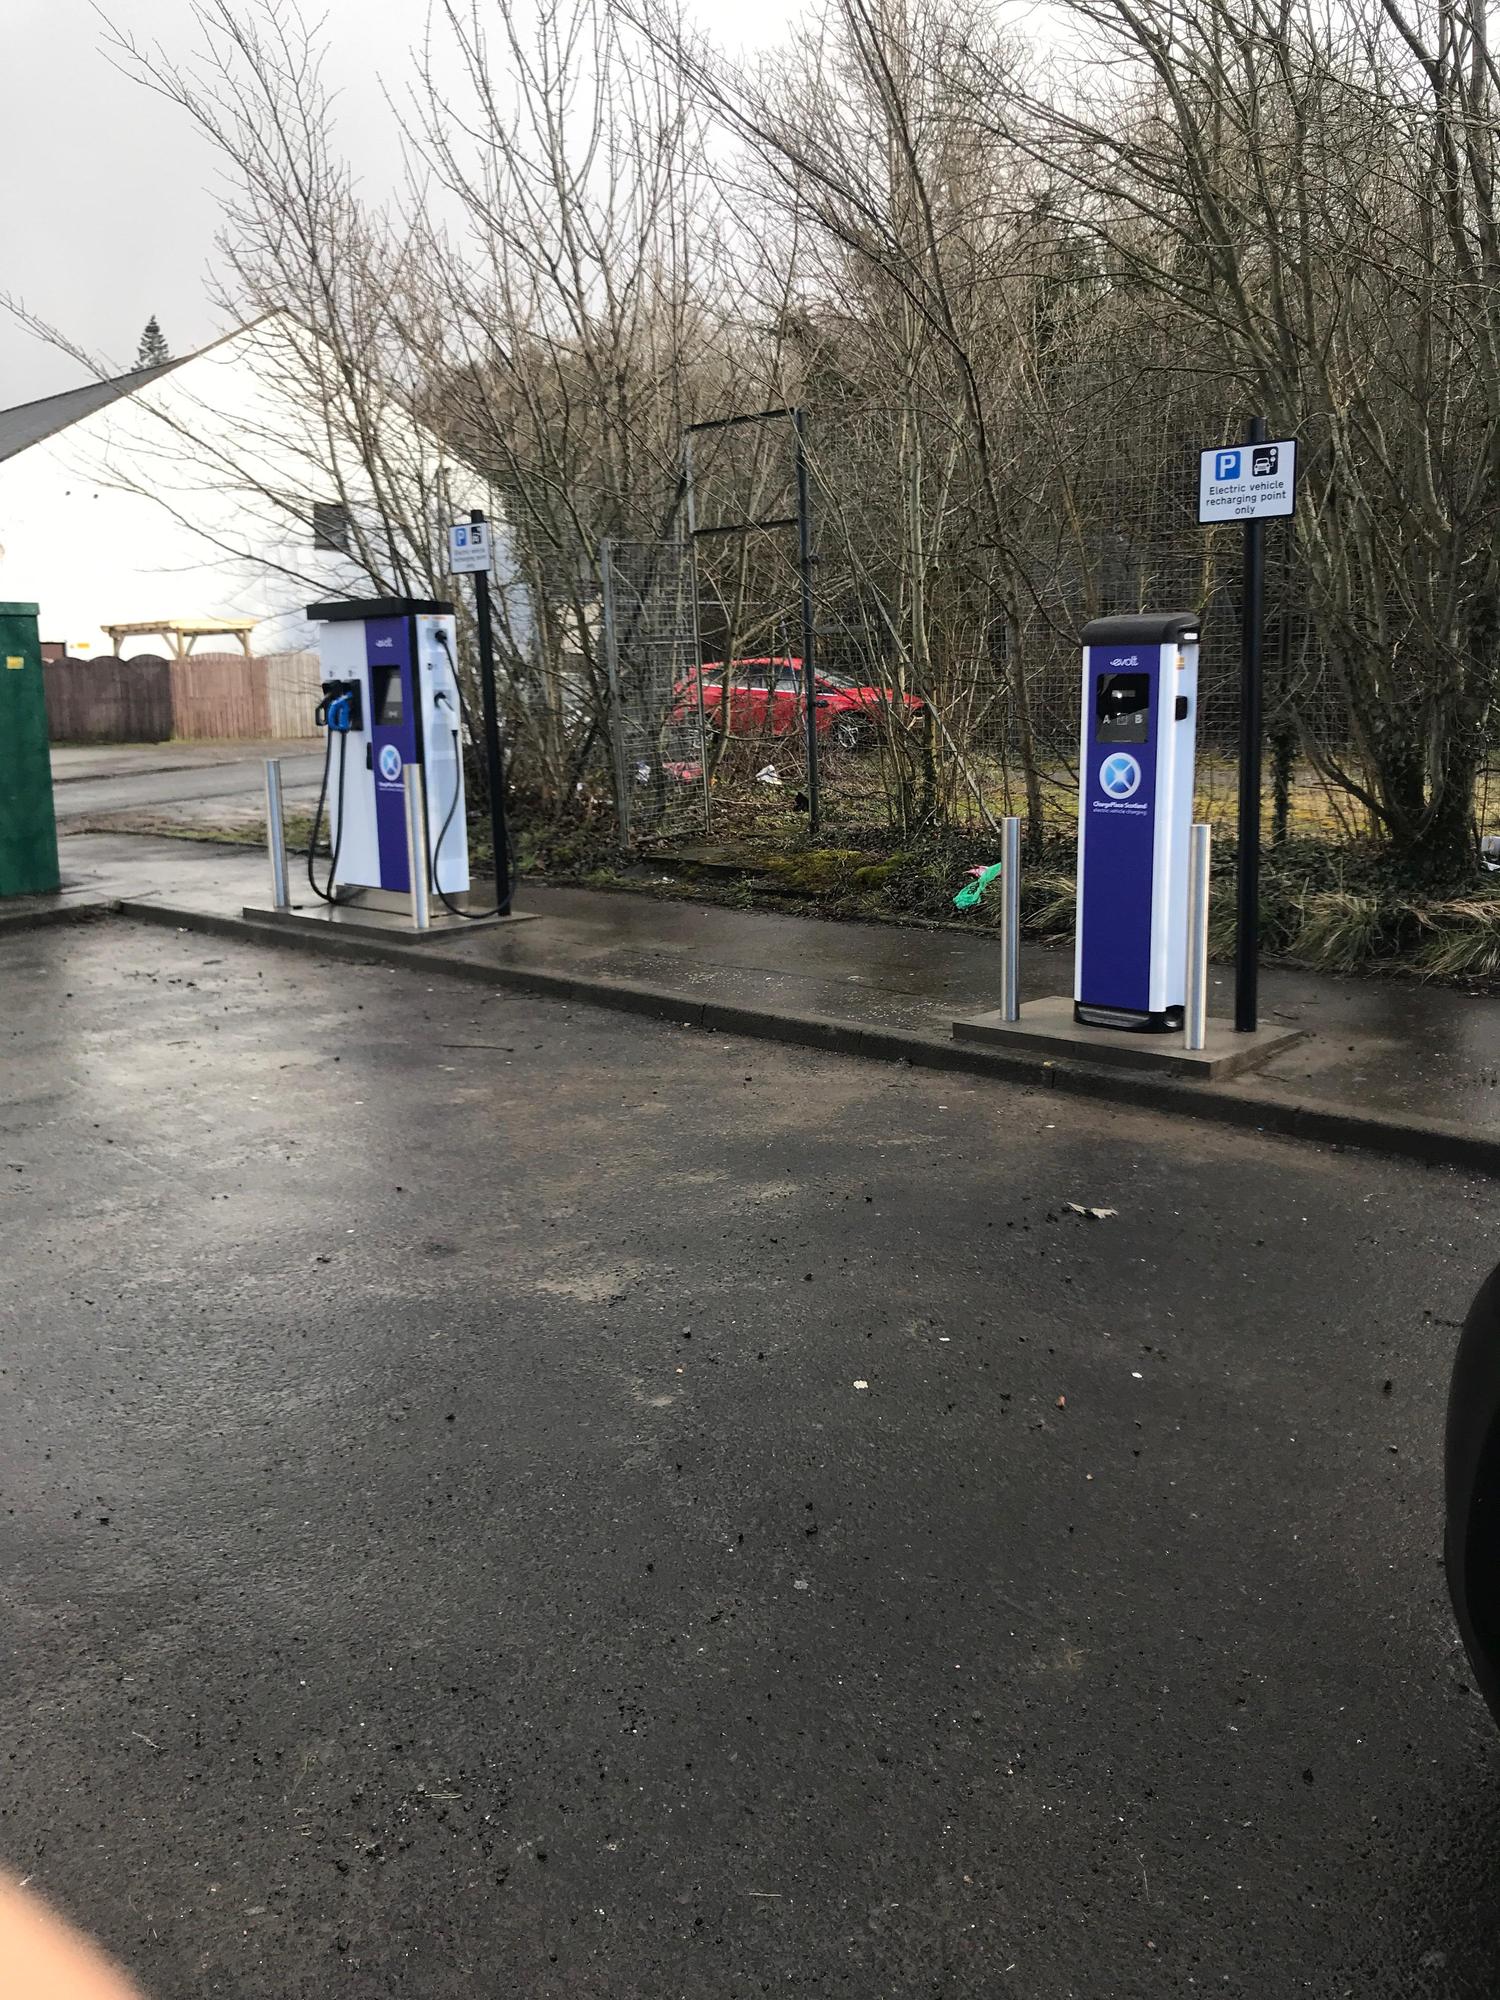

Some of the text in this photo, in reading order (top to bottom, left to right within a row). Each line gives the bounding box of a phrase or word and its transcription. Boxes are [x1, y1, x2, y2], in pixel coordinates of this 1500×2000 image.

[1220, 454, 1236, 477] P
[1209, 480, 1284, 496] Electric vehicle
[1206, 490, 1287, 506] recharging point
[1235, 505, 1255, 515] only
[1103, 714, 1143, 724] A B
